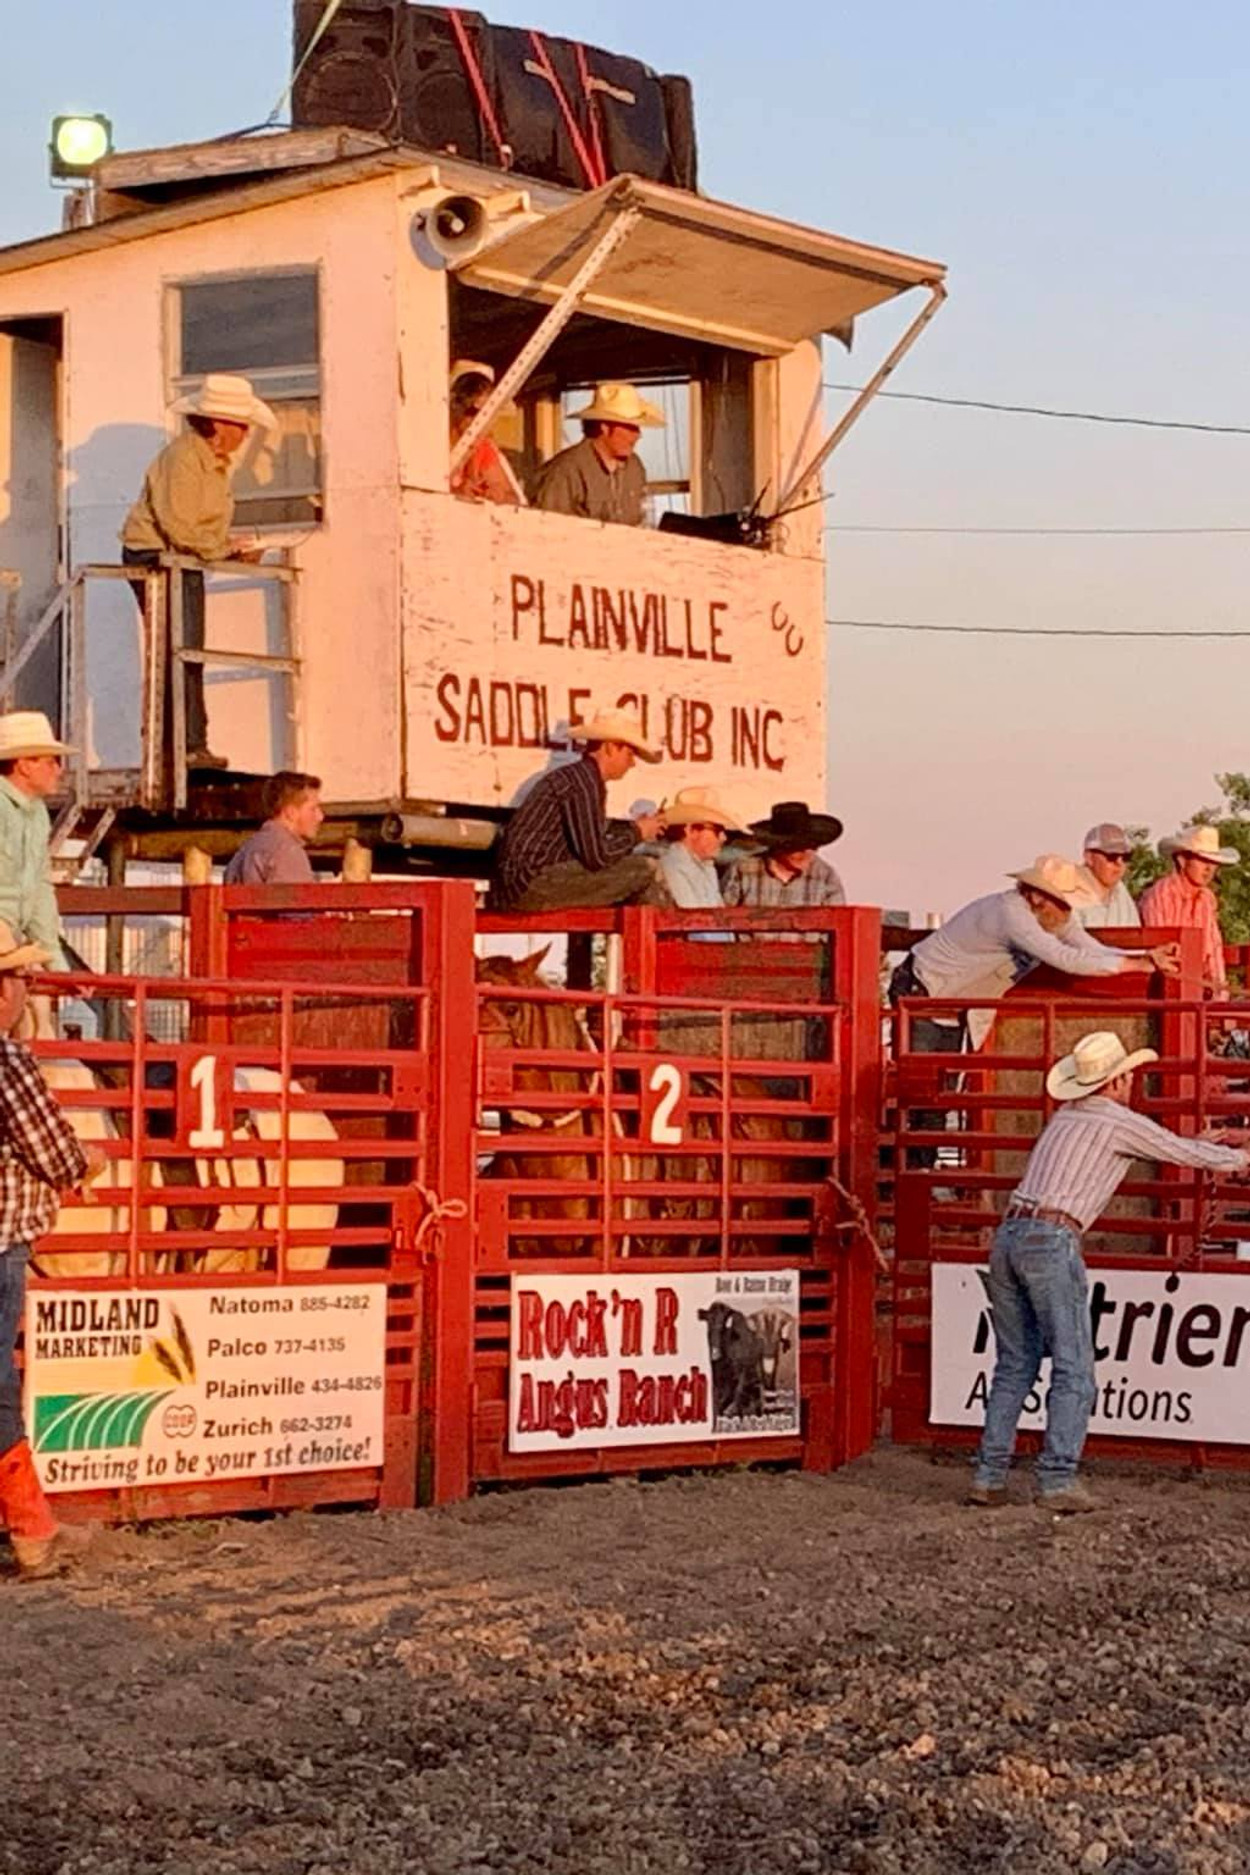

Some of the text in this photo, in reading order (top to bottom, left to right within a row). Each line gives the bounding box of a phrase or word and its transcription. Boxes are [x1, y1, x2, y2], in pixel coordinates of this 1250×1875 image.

[510, 573, 732, 664] PLAINVILLE
[731, 705, 785, 773] INC
[189, 1055, 224, 1148] 1
[649, 1064, 683, 1145] 2
[35, 1298, 160, 1334] MIDLAND
[209, 1296, 293, 1314] Natoma
[517, 1286, 679, 1360] Rock'n R
[35, 1335, 143, 1359] MARKETING
[207, 1337, 345, 1358] Palco 737-4135
[205, 1376, 382, 1399] Plainville 434-4826
[517, 1366, 708, 1439] Angus Ranch
[1022, 1376, 1192, 1423] Stions
[202, 1416, 352, 1439] Zurich 662-3274
[45, 1436, 371, 1485] Striving to be your 1st choice!
